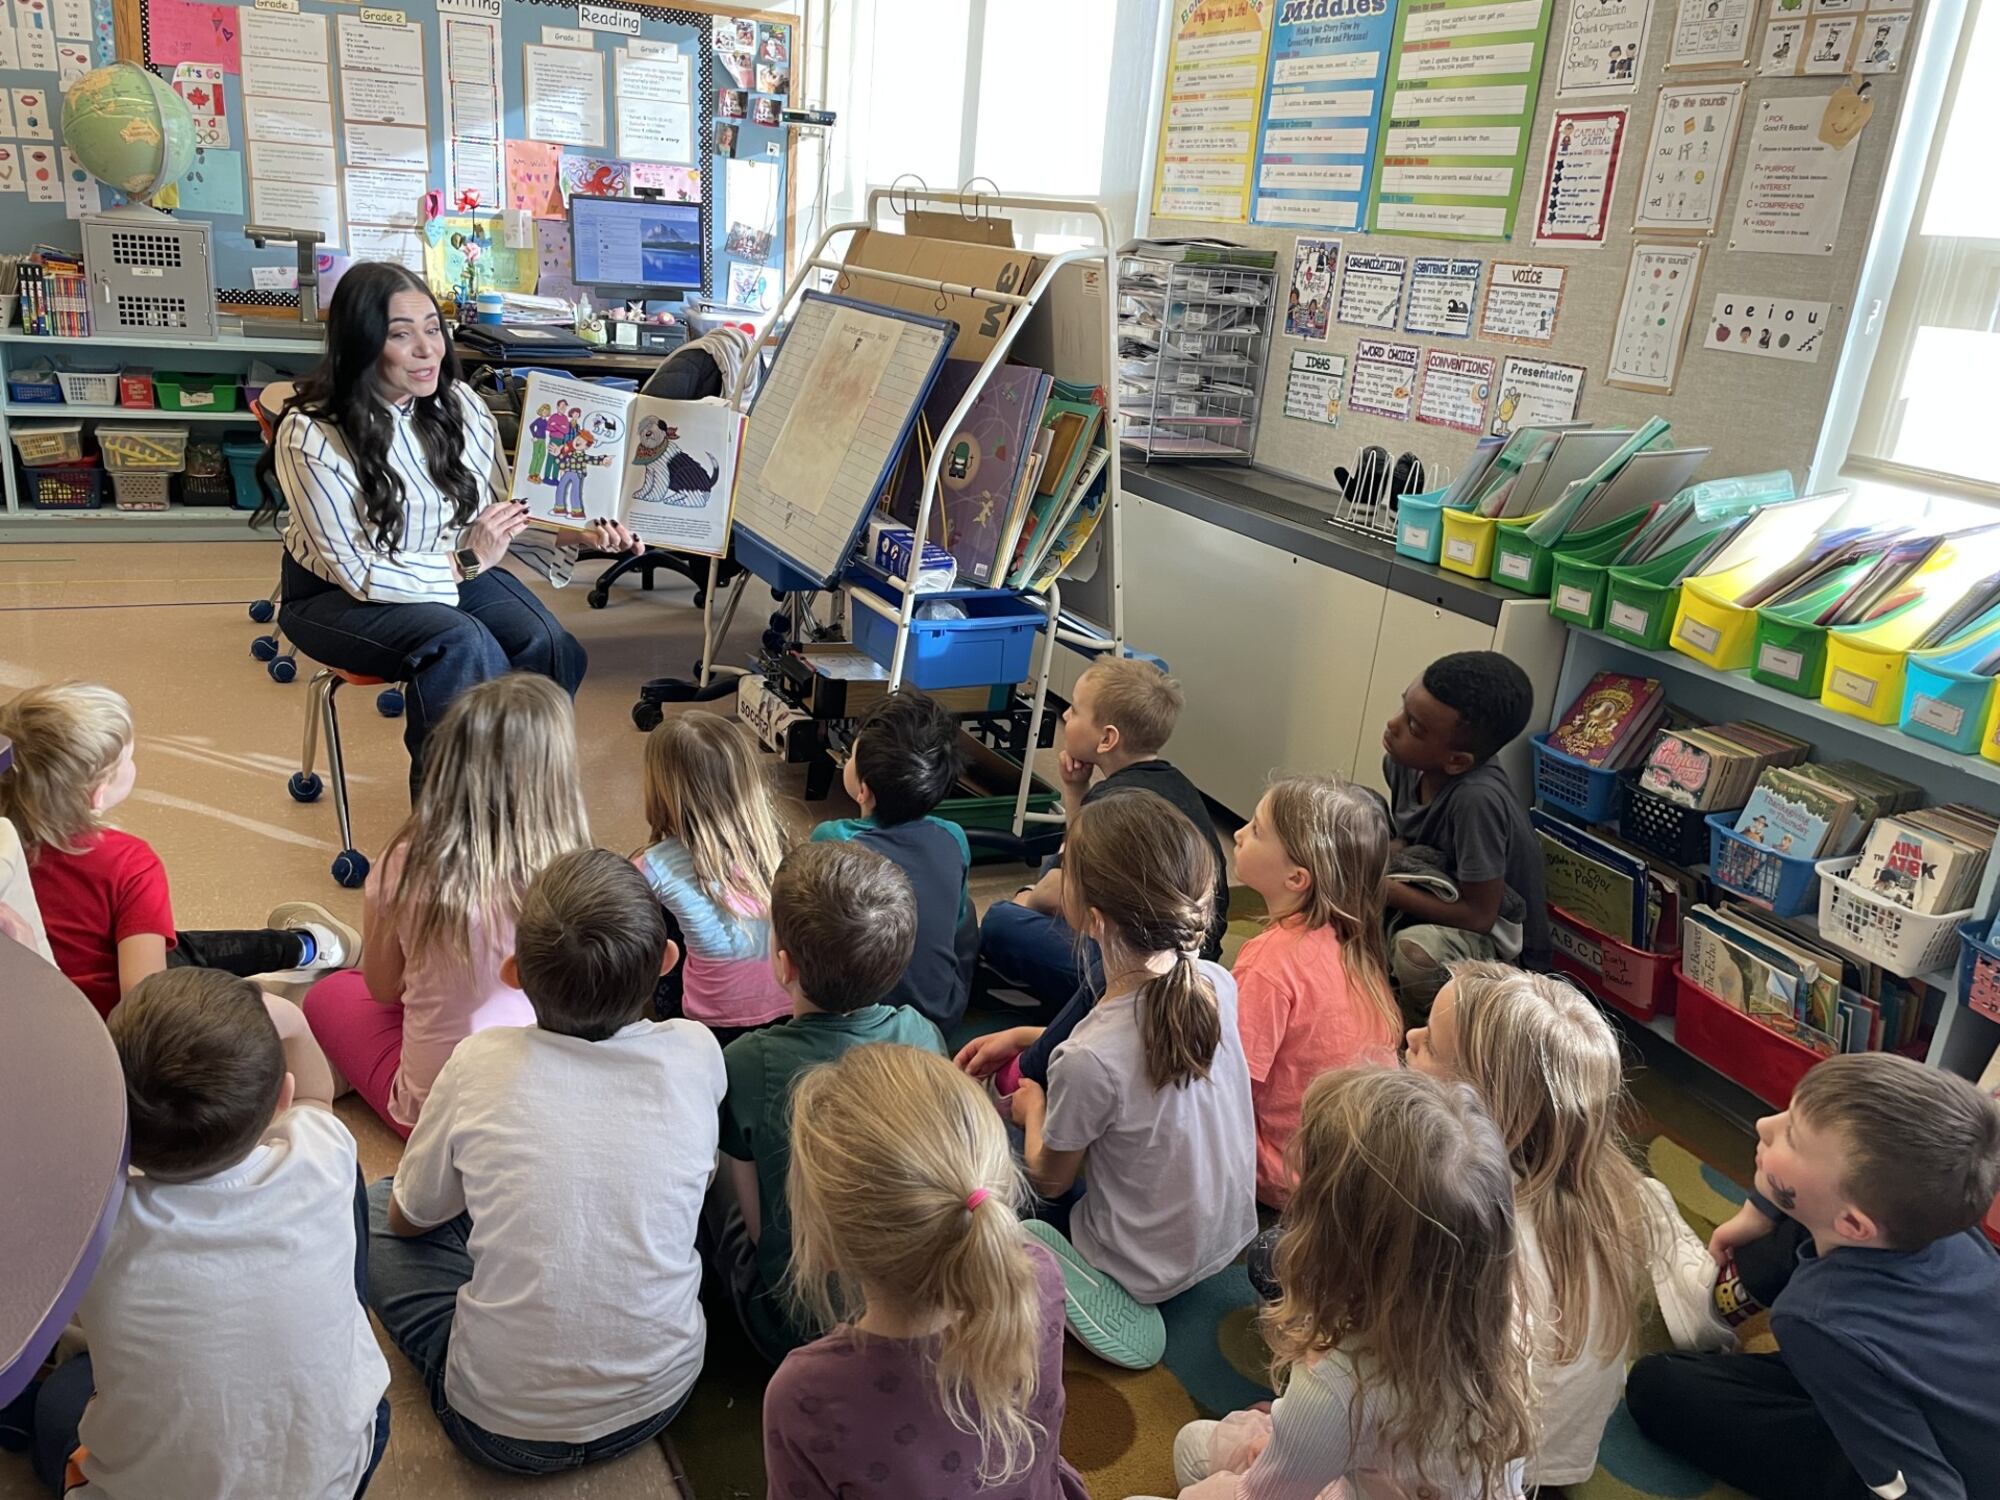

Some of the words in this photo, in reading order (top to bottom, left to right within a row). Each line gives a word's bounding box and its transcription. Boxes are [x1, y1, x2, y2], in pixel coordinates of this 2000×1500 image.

[256, 0, 288, 10] Grade
[441, 0, 500, 16] riting
[1280, 0, 1386, 24] Middles
[1575, 4, 1627, 21] Capitalization
[363, 9, 393, 23] Grade
[396, 12, 403, 22] 2
[581, 7, 640, 33] Reading
[1323, 24, 1338, 32] Story
[554, 32, 575, 42] Grade
[1568, 53, 1599, 72] Spelling
[206, 68, 221, 80] Go
[1682, 98, 1696, 108] the
[1699, 96, 1728, 107] sounds
[1573, 128, 1606, 139] CAPTAIN
[1759, 183, 1792, 191] INTEREST
[1746, 200, 1753, 208] C
[1759, 201, 1805, 209] COMPREHEND
[1743, 217, 1750, 226] K
[1755, 219, 1776, 227] KNOW
[1349, 258, 1402, 272] ORGANIZATION
[1655, 255, 1666, 264] the
[1668, 256, 1688, 265] sounds
[1416, 262, 1448, 275] SENTENCE
[1450, 264, 1478, 276] FLUENCY
[1511, 269, 1543, 284] VOICE
[1724, 303, 1734, 315] a
[1746, 305, 1756, 317] e
[1768, 304, 1775, 319] i
[1785, 309, 1794, 321] o
[1808, 311, 1818, 324] u
[1361, 344, 1385, 358] WORD
[1387, 348, 1416, 363] CHOICE
[1305, 356, 1331, 371] IDEAS
[1430, 355, 1489, 376] CONVENTIONS
[1510, 362, 1574, 383] Presentation
[740, 700, 770, 740] SOCCER
[1692, 925, 1703, 962] Beaver
[1706, 943, 1717, 969] Echo
[1703, 969, 1716, 993] The
